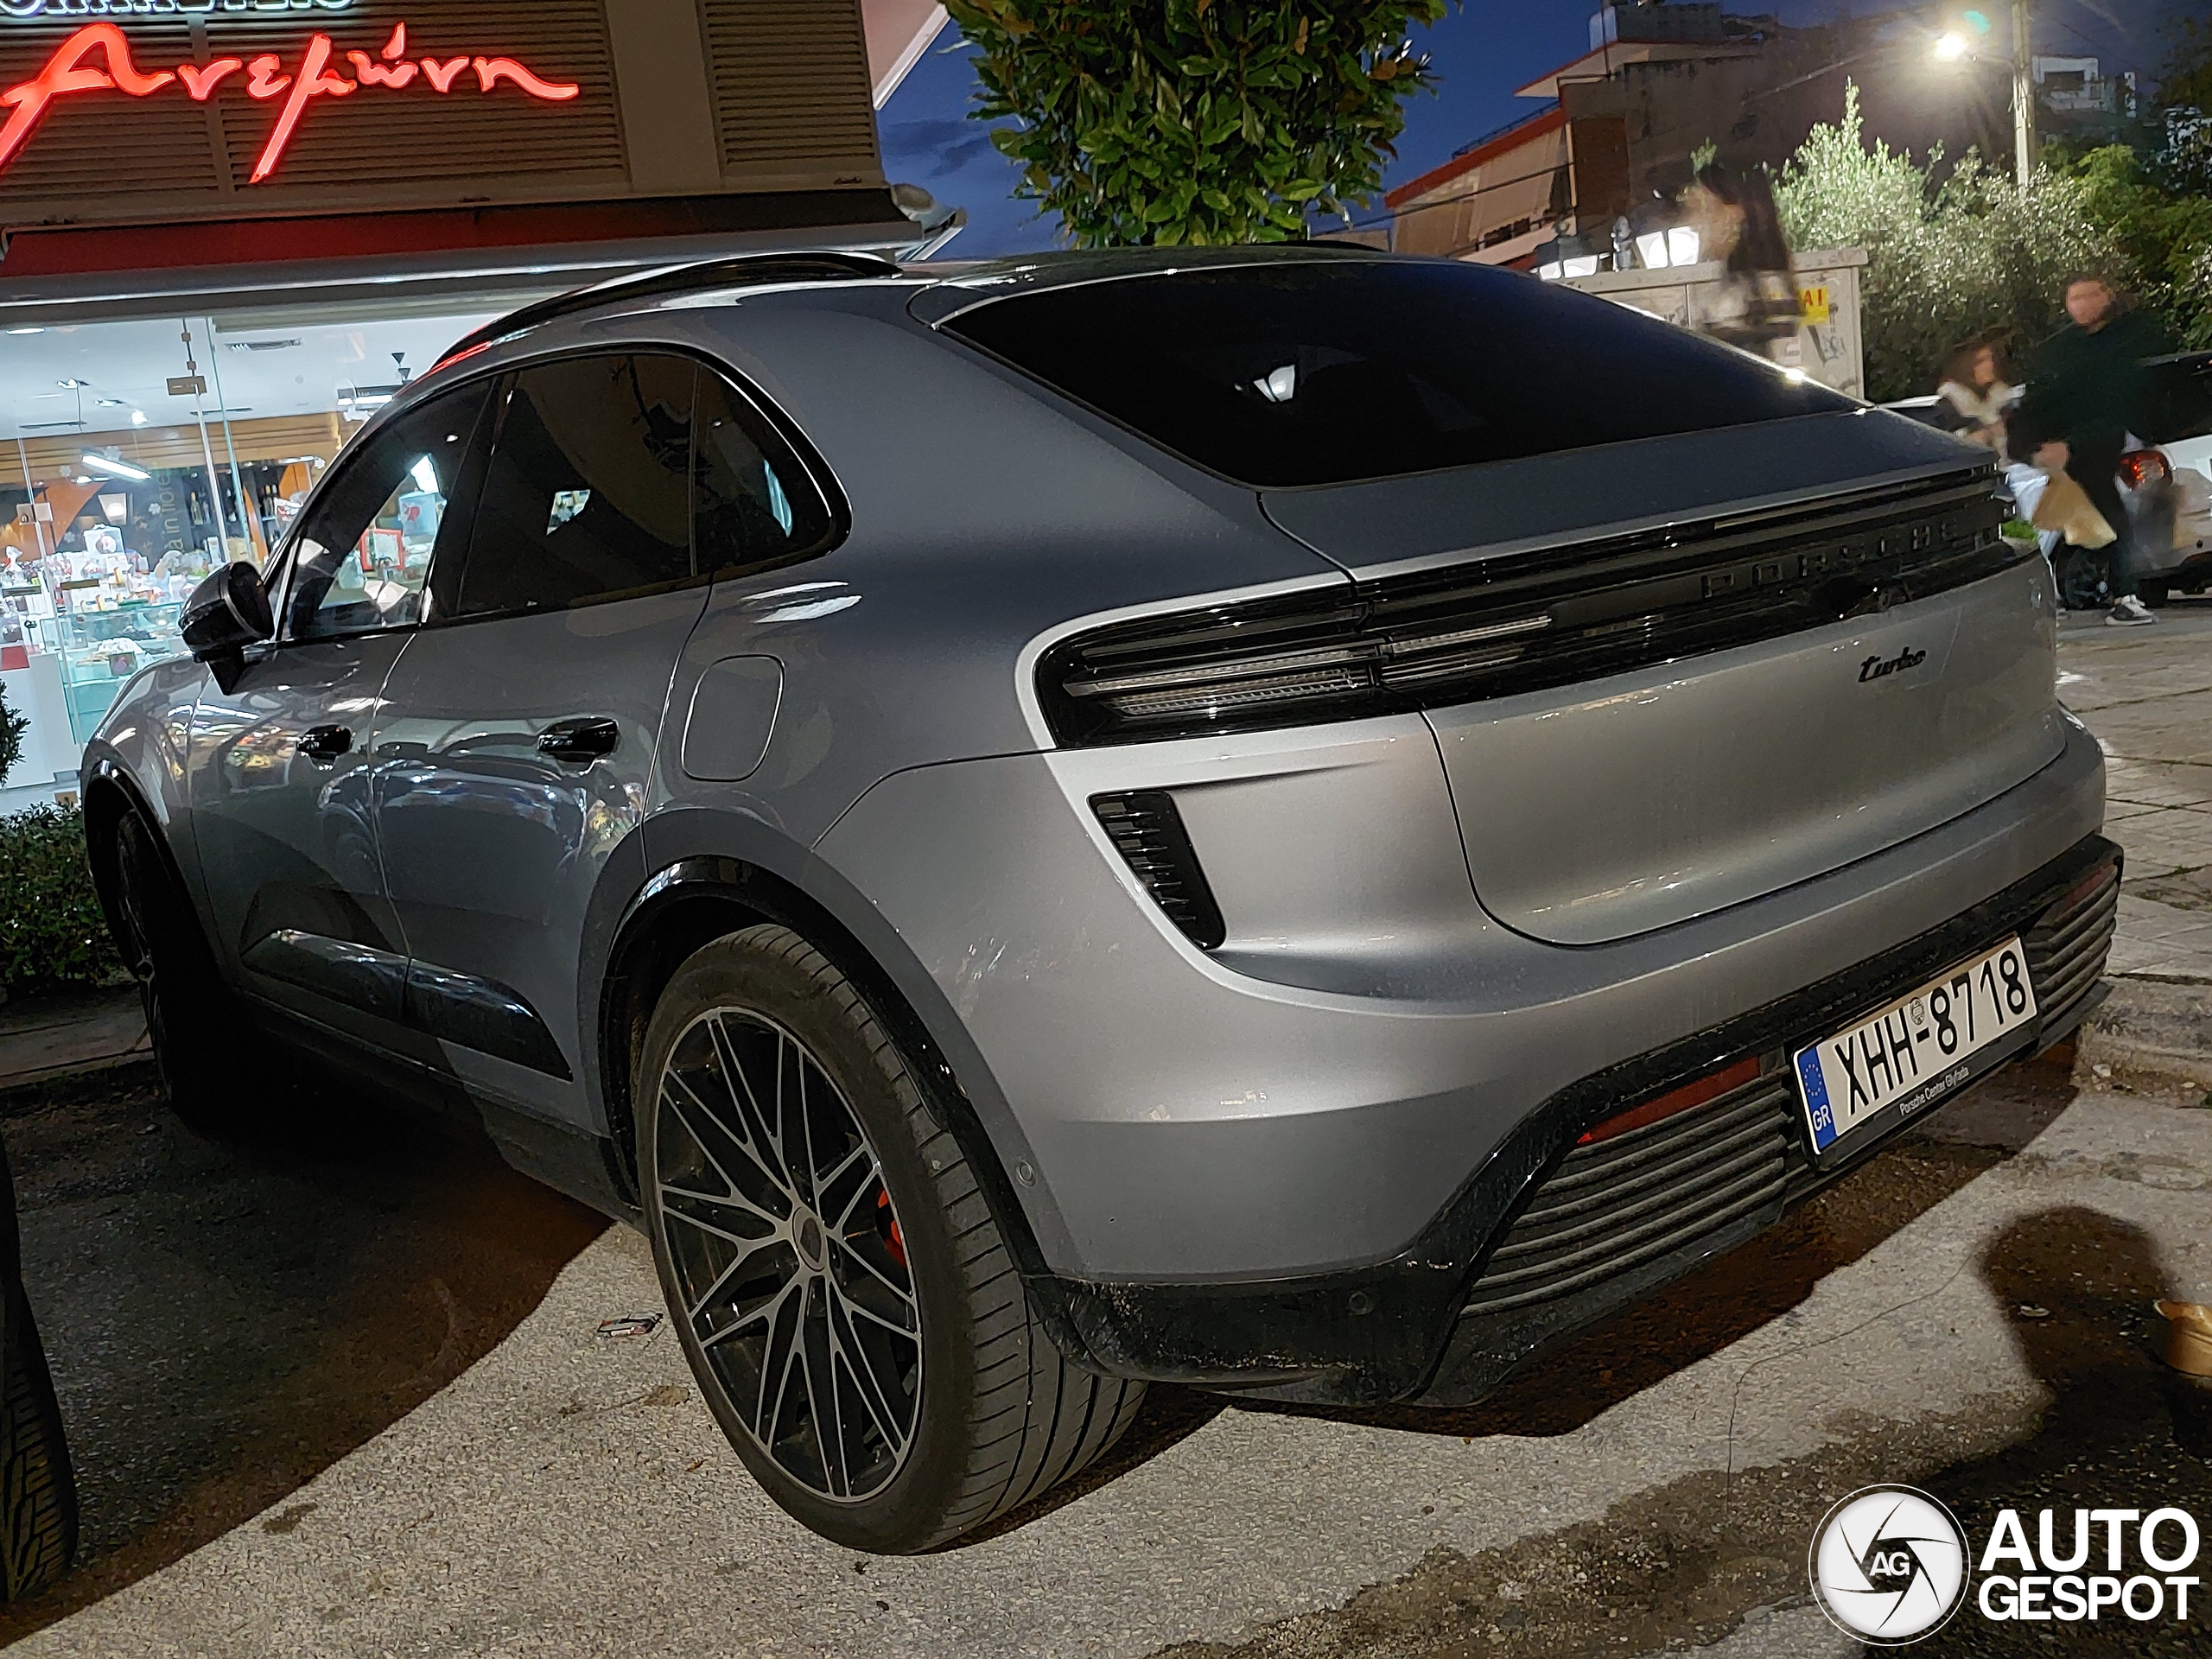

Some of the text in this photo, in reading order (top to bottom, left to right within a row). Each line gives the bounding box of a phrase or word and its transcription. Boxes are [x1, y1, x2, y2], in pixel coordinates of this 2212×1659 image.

[1700, 521, 1953, 599] PORSCHE
[1858, 646, 1927, 683] turbo
[1834, 950, 2027, 1116] XHH-8718
[1899, 1065, 1970, 1116] Porsche Center Glyfada
[1812, 1104, 1833, 1132] GR
